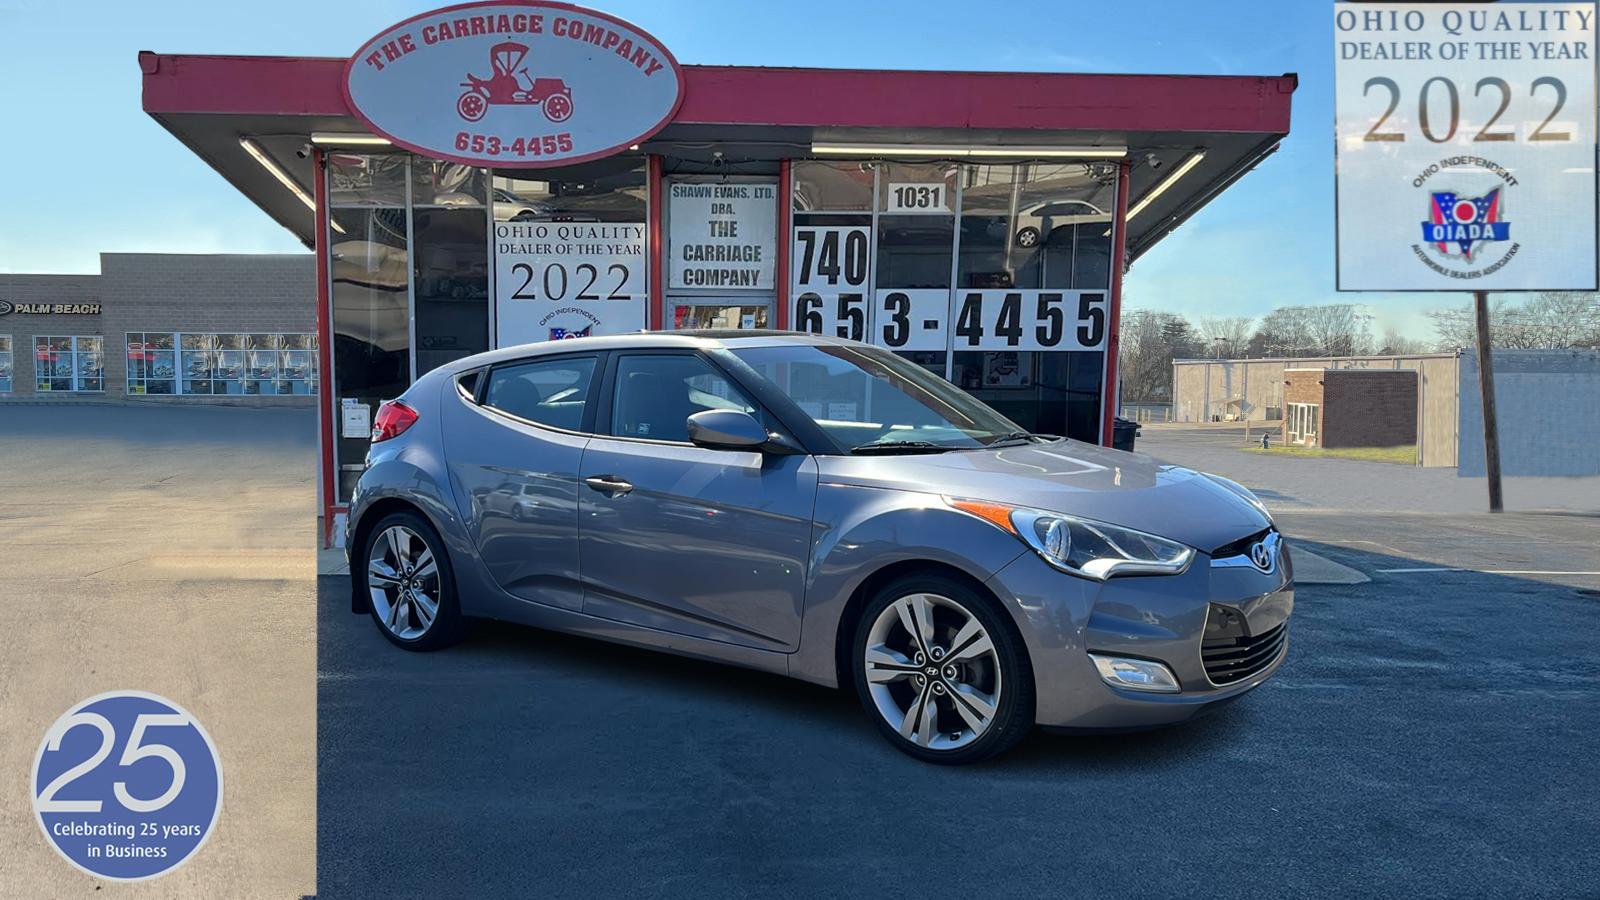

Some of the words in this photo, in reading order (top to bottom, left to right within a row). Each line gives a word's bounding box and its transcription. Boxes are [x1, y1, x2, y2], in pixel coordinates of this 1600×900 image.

[1336, 10, 1425, 31] OHIO
[1442, 10, 1592, 36] QUALITY
[365, 33, 420, 72] THE
[422, 14, 544, 46] CARRIAGE
[552, 17, 664, 77] COMPANY
[1340, 42, 1433, 60] DEALER
[1439, 42, 1469, 60] OF
[1475, 42, 1521, 60] THE
[1528, 42, 1589, 60] YEAR
[1363, 76, 1570, 143] 2022
[454, 132, 573, 156] 653-4455
[1412, 164, 1439, 188] OHIO
[1440, 155, 1519, 187] INDEPENDENT
[672, 185, 711, 198] SHAWN
[754, 187, 774, 199] LTD.
[895, 186, 940, 208] 1031
[711, 203, 736, 215] DBA.
[497, 226, 548, 239] OHIO
[557, 226, 644, 240] QUALITY
[708, 220, 737, 237] THE
[1432, 224, 1495, 240] OIADA
[500, 244, 551, 255] DEALER
[555, 244, 573, 255] OF
[576, 244, 603, 255] THE
[607, 244, 641, 255] YEAR
[683, 244, 762, 262] CARRIAGE
[797, 230, 868, 287] 740
[1411, 244, 1449, 277] AUTOMOBILE
[1449, 270, 1482, 279] DEALERS
[1483, 242, 1521, 276] ASSOCIATION
[511, 262, 631, 301] 2022
[683, 268, 760, 286] COMPANY
[15, 303, 51, 314] PALM
[54, 304, 100, 314] BEACH
[539, 312, 555, 327] OHIO
[555, 307, 601, 326] INDEPENDENT
